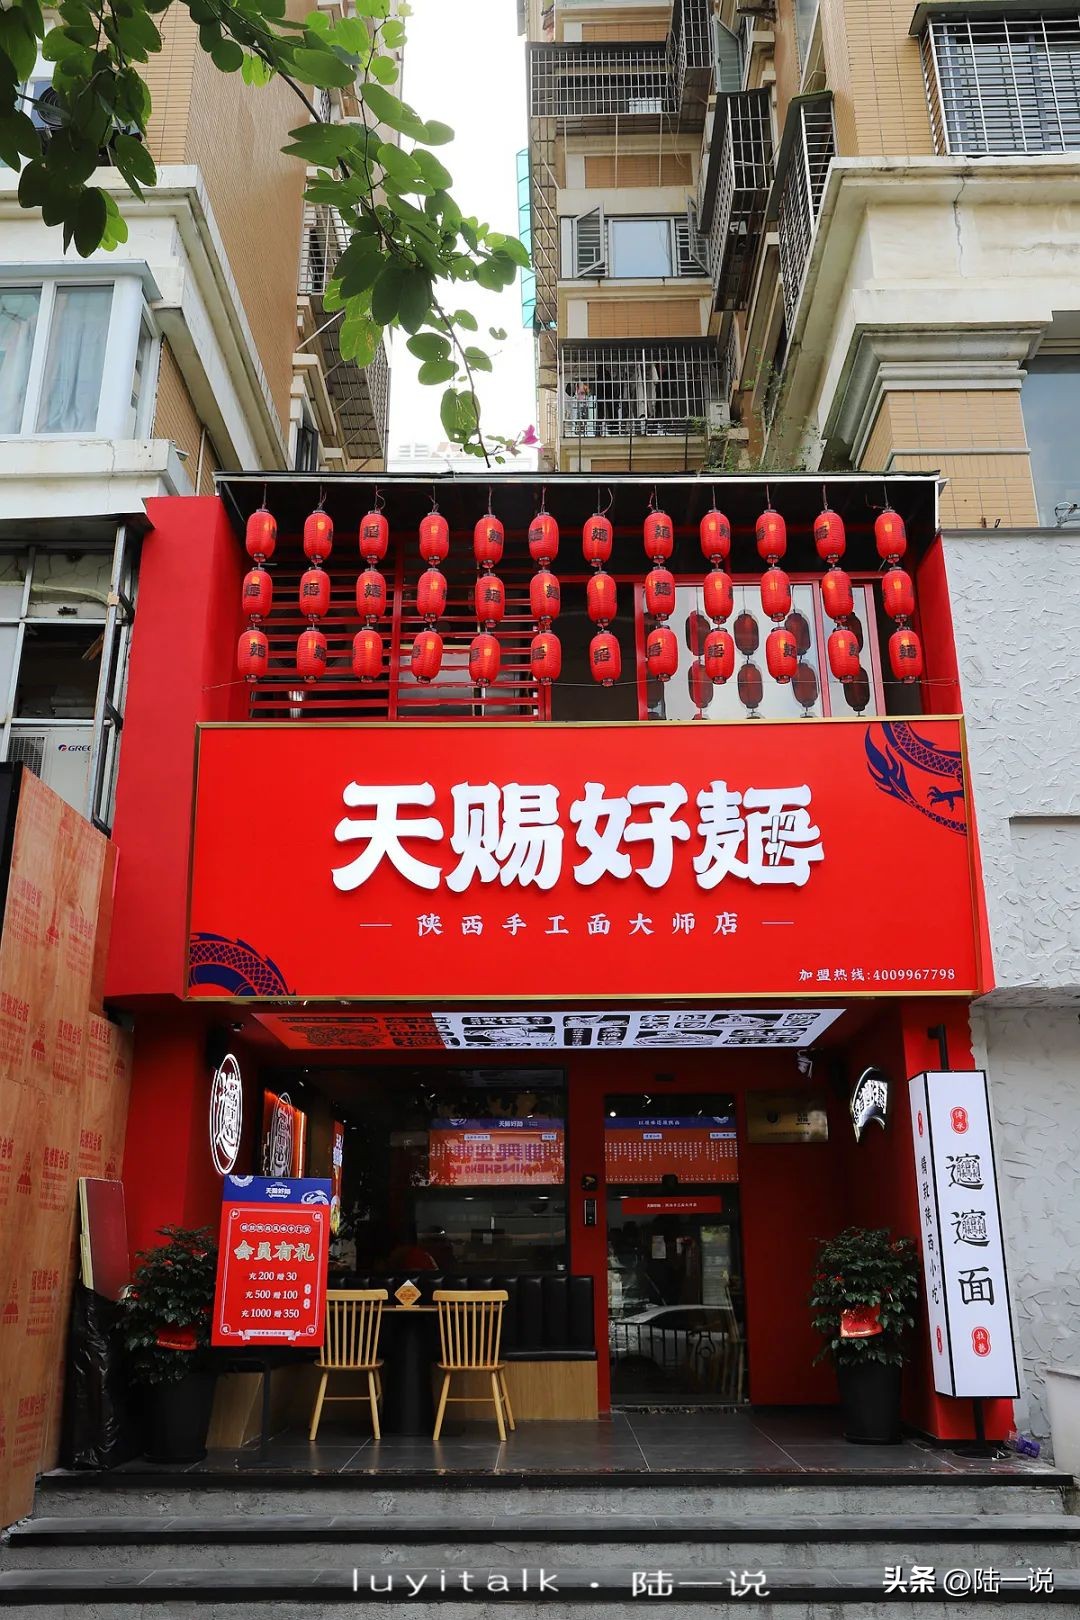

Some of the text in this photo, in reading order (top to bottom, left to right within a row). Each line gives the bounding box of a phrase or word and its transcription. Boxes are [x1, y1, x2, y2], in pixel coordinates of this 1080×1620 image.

[416, 912, 740, 937] 陕西手工面大师店
[798, 967, 956, 982] 加盟热线:4009967798
[233, 1239, 315, 1262] 会员有礼
